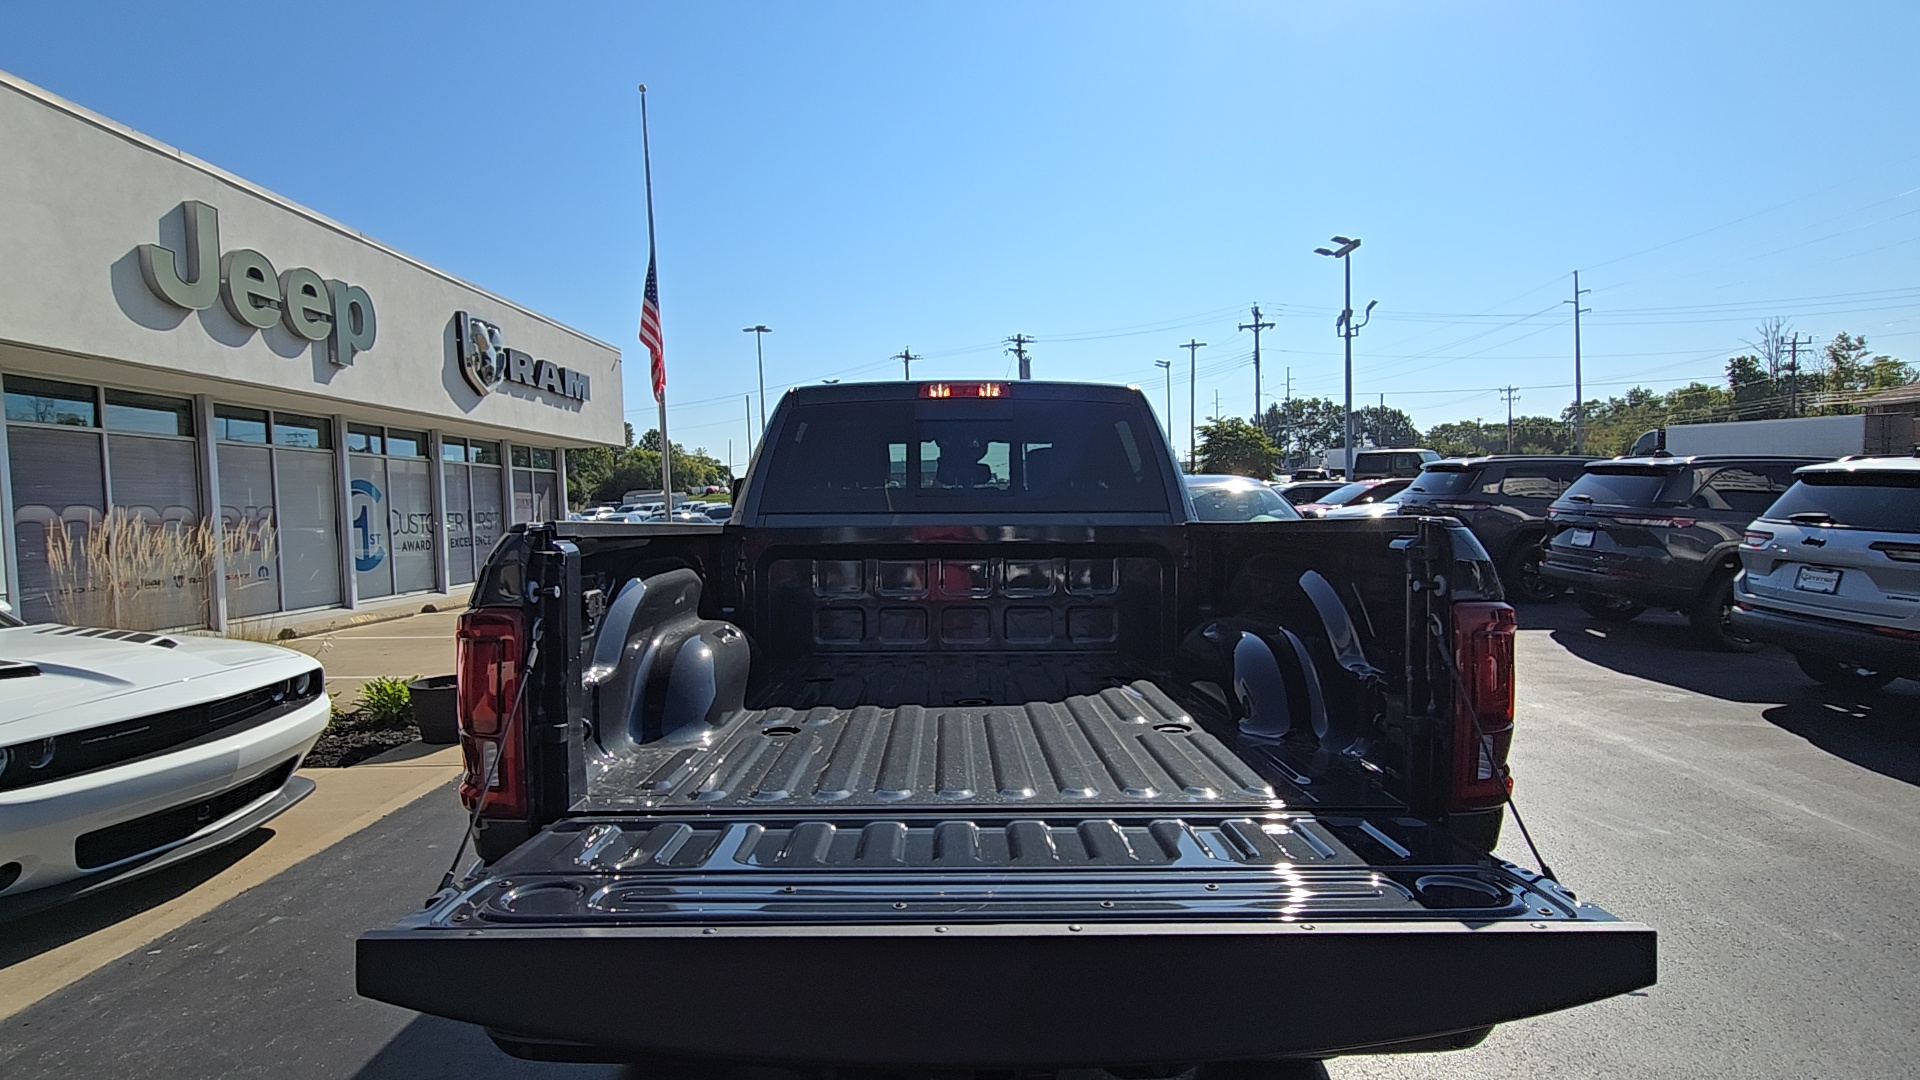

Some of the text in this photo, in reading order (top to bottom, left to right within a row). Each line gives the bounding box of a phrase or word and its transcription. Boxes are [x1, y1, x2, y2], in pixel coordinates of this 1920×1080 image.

[139, 200, 376, 368] Jeep
[503, 347, 591, 401] RAM
[387, 509, 464, 536] CUSTOER
[401, 535, 491, 552] AWARD EXCELENCE
